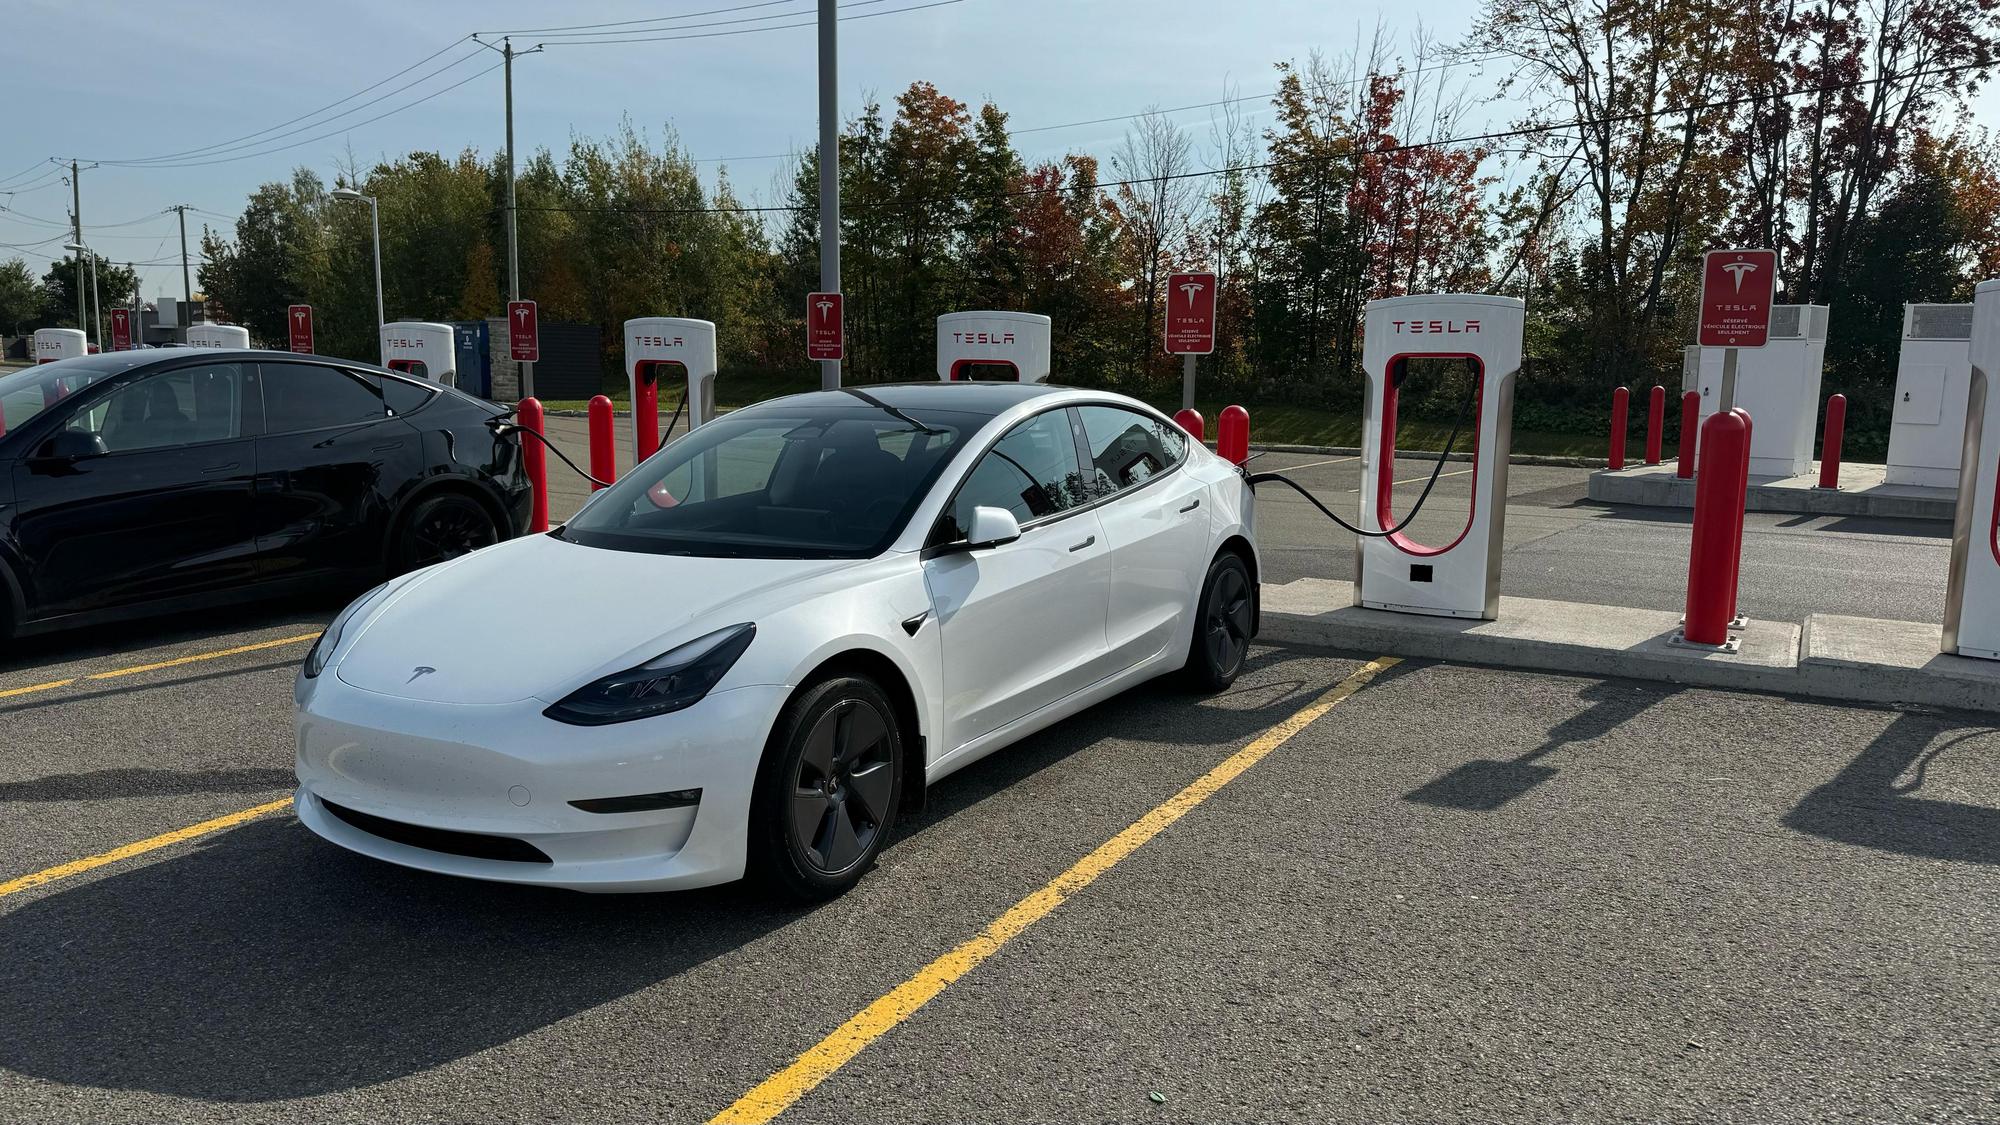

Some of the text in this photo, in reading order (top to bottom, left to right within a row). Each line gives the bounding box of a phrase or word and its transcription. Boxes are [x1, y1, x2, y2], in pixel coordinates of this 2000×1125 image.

[1392, 321, 1480, 333] TESLA
[387, 339, 424, 348] TESLA
[635, 336, 683, 347] TESLA
[953, 333, 1014, 344] TESLA
[37, 342, 61, 350] TESLA
